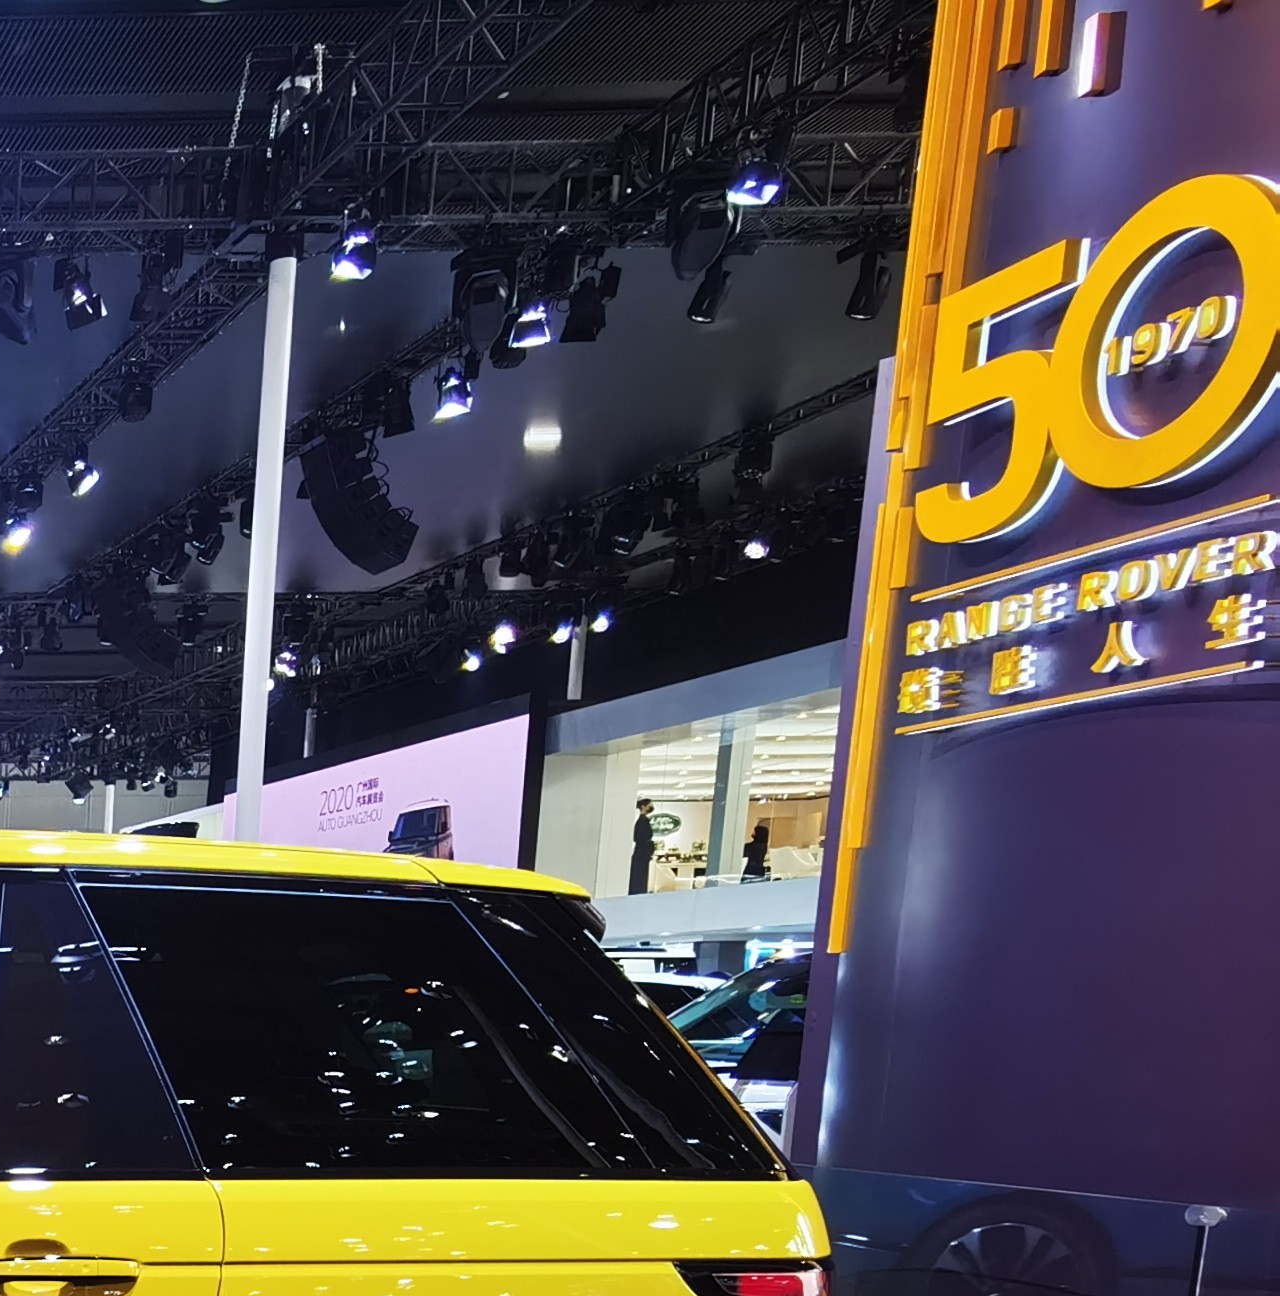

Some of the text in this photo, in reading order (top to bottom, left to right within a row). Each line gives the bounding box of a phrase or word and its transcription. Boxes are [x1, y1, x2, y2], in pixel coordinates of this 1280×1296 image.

[916, 174, 1280, 543] 50
[1104, 296, 1237, 377] 1970
[906, 530, 1277, 656] RANGE ROVER
[320, 785, 354, 816] 2020
